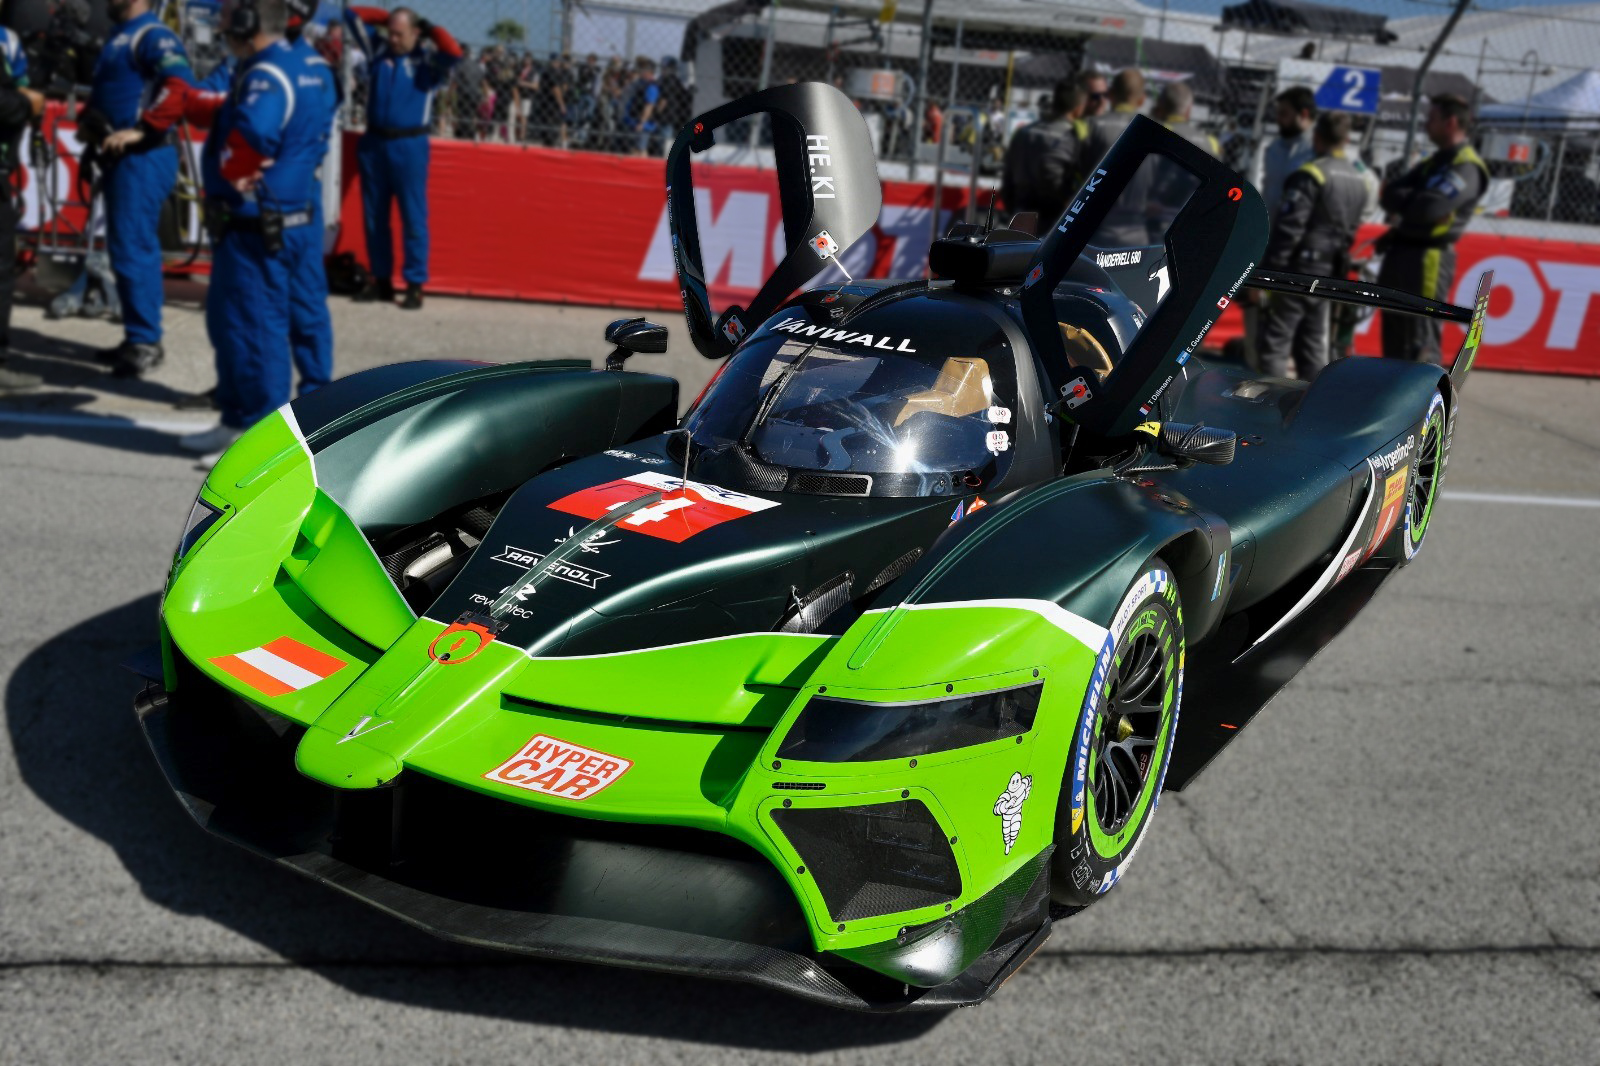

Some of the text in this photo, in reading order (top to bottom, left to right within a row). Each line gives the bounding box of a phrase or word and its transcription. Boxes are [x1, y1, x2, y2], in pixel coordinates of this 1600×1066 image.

[1340, 70, 1366, 108] 2
[805, 134, 836, 200] HE.KI
[1058, 168, 1108, 233] HE.KI
[770, 316, 918, 354] VANWALL
[1186, 319, 1213, 353] E.Guerrieri
[1147, 374, 1173, 406] T.Dillmann
[469, 593, 534, 619] revntec
[1117, 603, 1131, 634] PILOT
[1131, 583, 1147, 607] SPORT
[1077, 645, 1111, 782] MICHELIN
[497, 758, 601, 797] CAR
[523, 739, 620, 779] HYPER
